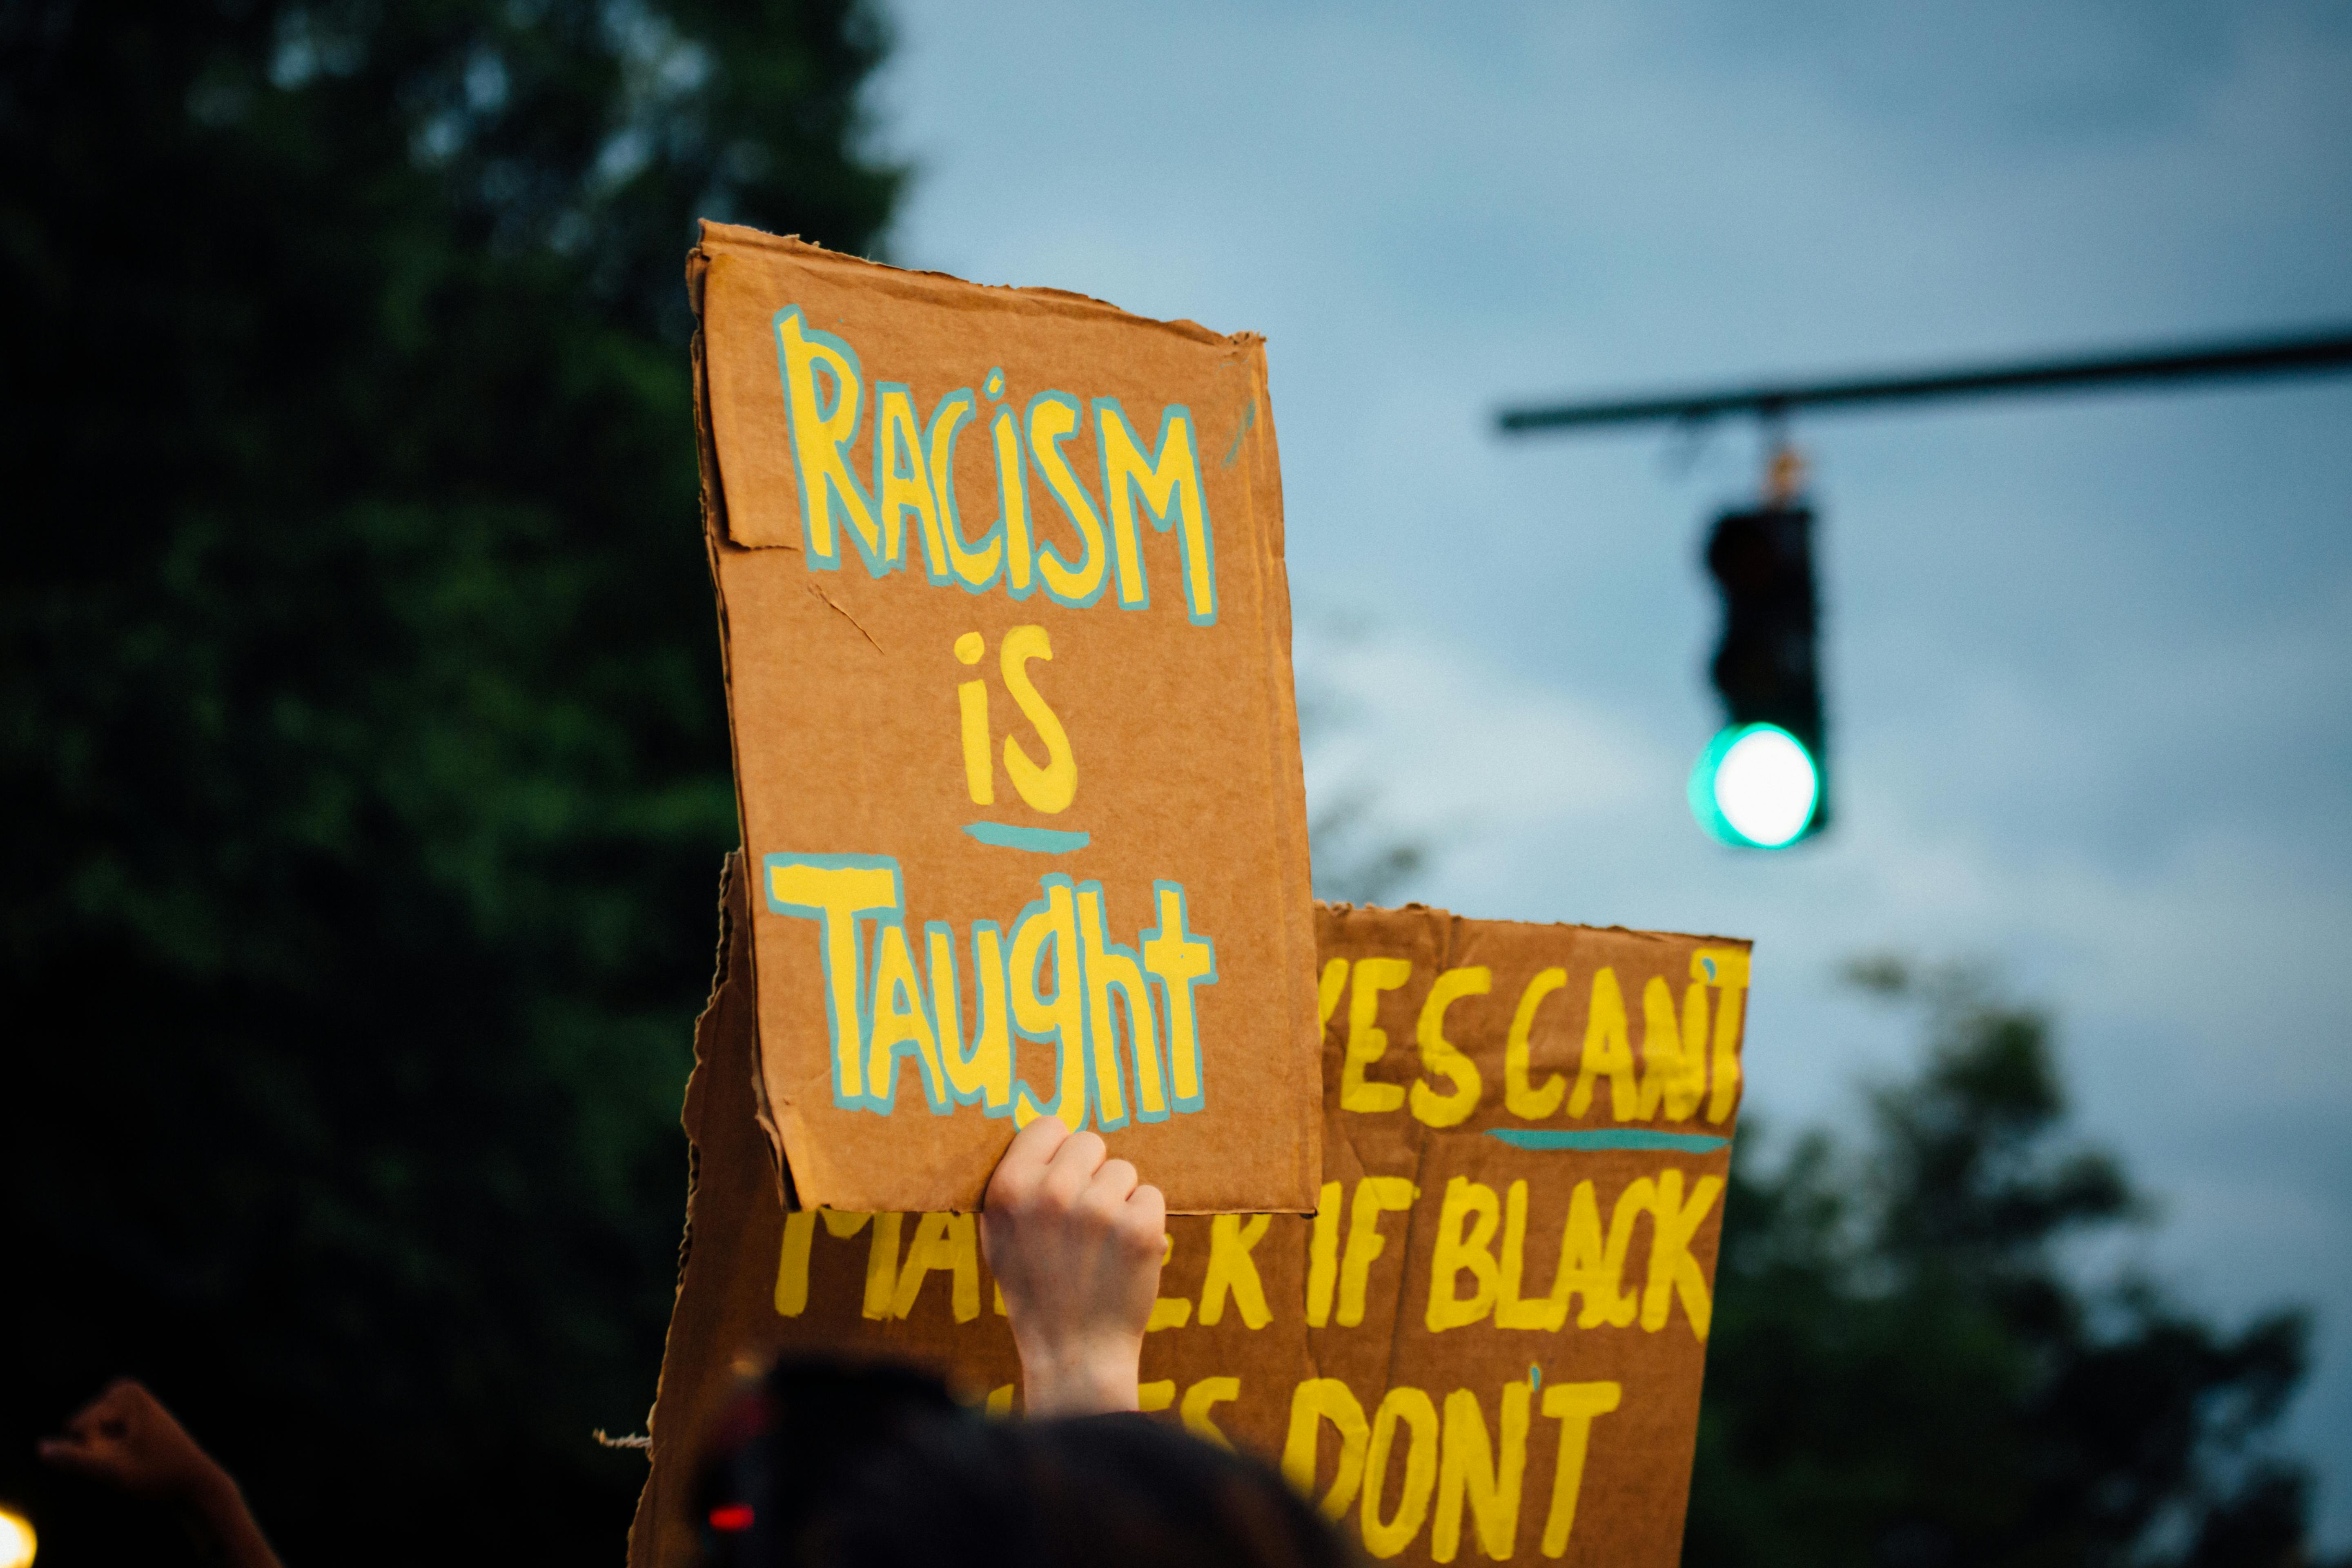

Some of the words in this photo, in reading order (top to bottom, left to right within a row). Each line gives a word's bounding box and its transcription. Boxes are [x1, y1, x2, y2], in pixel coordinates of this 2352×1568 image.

[1505, 947, 1750, 1126] CAN'T
[1313, 1176, 1421, 1328] IF
[1425, 1167, 1724, 1343] BLACK
[1282, 1361, 1621, 1564] DON'T
